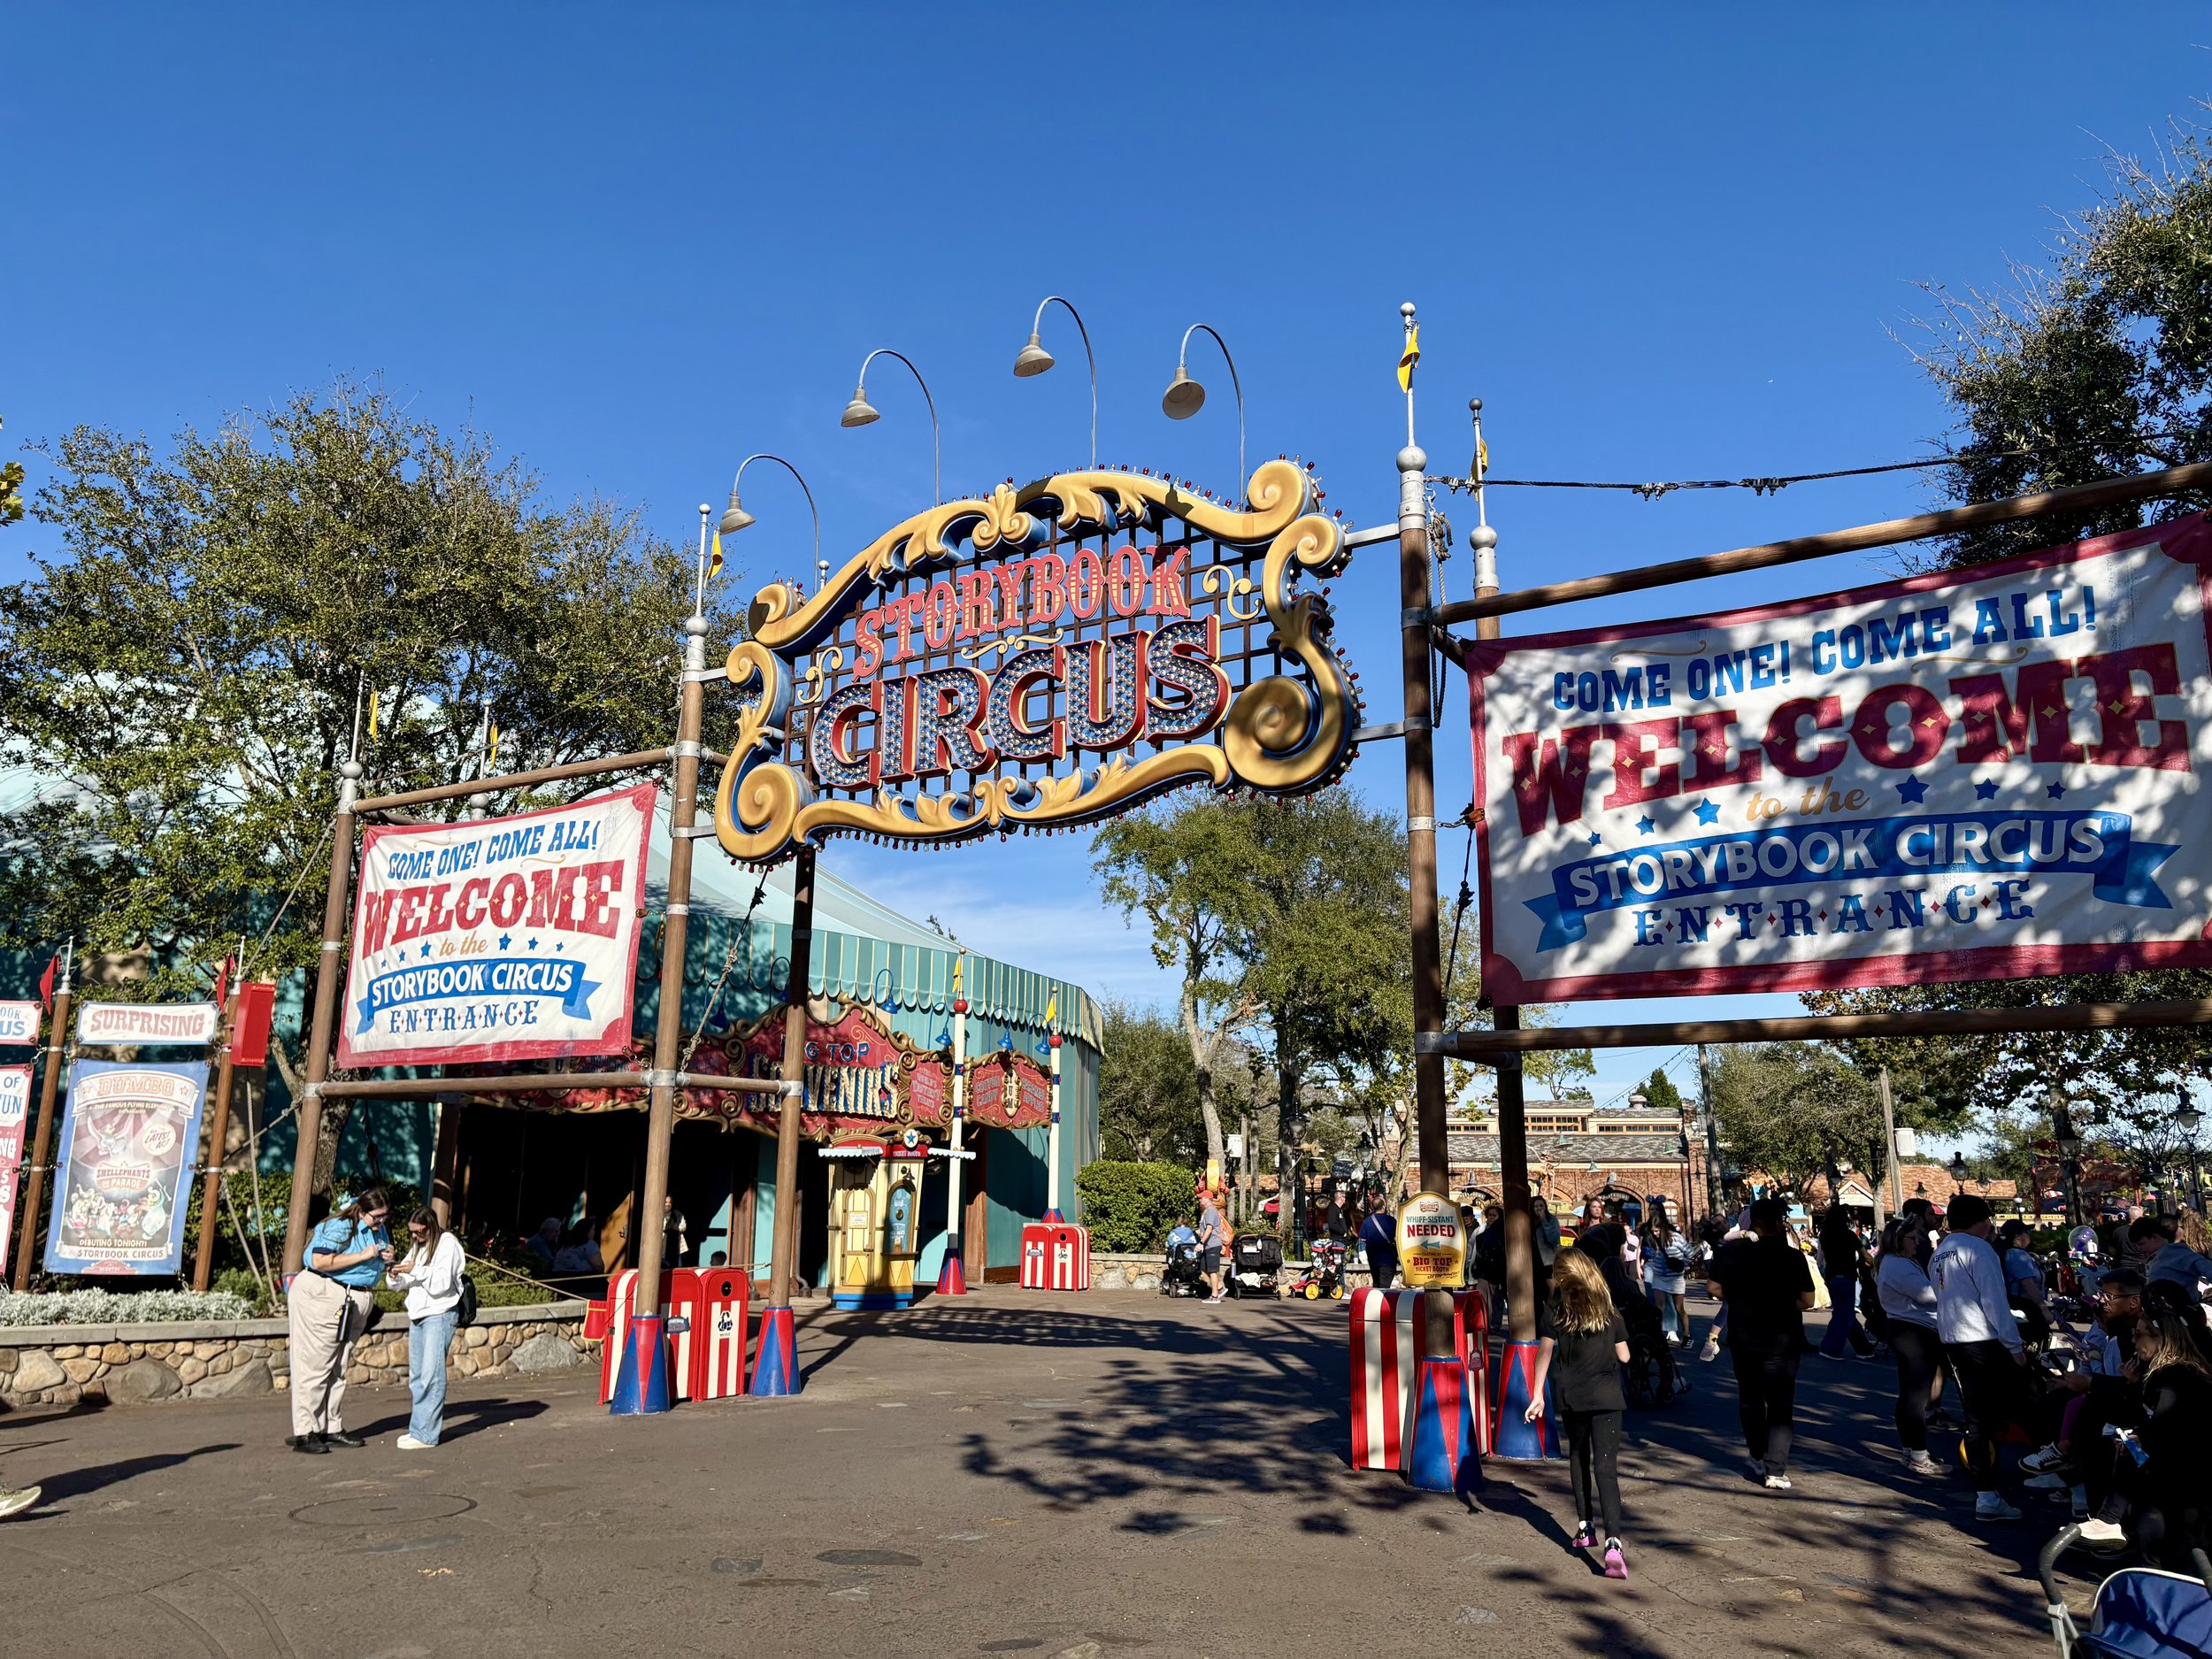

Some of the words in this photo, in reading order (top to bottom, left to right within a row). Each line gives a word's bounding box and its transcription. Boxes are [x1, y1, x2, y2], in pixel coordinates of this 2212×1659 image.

[851, 545, 1190, 681] STORYBOOK
[1553, 662, 1671, 713] COME
[1686, 640, 1791, 701] ONE!
[1811, 605, 1952, 674] COME
[1971, 585, 2097, 647] ALL!
[811, 614, 1233, 793] CIRCUS
[1502, 641, 2192, 838] WELCOME
[1745, 788, 1788, 822] to
[1798, 776, 1871, 817] the
[387, 849, 434, 880] COME
[438, 840, 483, 877] ONE!
[486, 825, 542, 864] COME
[547, 819, 602, 852] ALL!
[1569, 826, 1881, 909] STORYBOOK
[1895, 817, 2108, 868] CIRCUS
[362, 858, 626, 961] WELCOME
[439, 936, 457, 956] to
[459, 931, 488, 956] the
[372, 964, 488, 1008] STORYBOOK
[491, 962, 574, 993] CIRCUS
[90, 1009, 204, 1036] SURPRISING
[826, 1041, 871, 1062] TOP
[4, 1076, 20, 1088] OF
[97, 1075, 175, 1096] DUMBO
[976, 1076, 1000, 1094] COTTON
[0, 1094, 23, 1115] UN
[111, 1179, 142, 1189] PARADE
[79, 1239, 112, 1248] DEBUTING
[1407, 1225, 1455, 1238] NEEDED
[77, 1249, 128, 1258] STORYBOOK
[132, 1249, 164, 1258] CIRCUS
[1413, 1257, 1430, 1266] BIG
[1432, 1257, 1452, 1266] TOP
